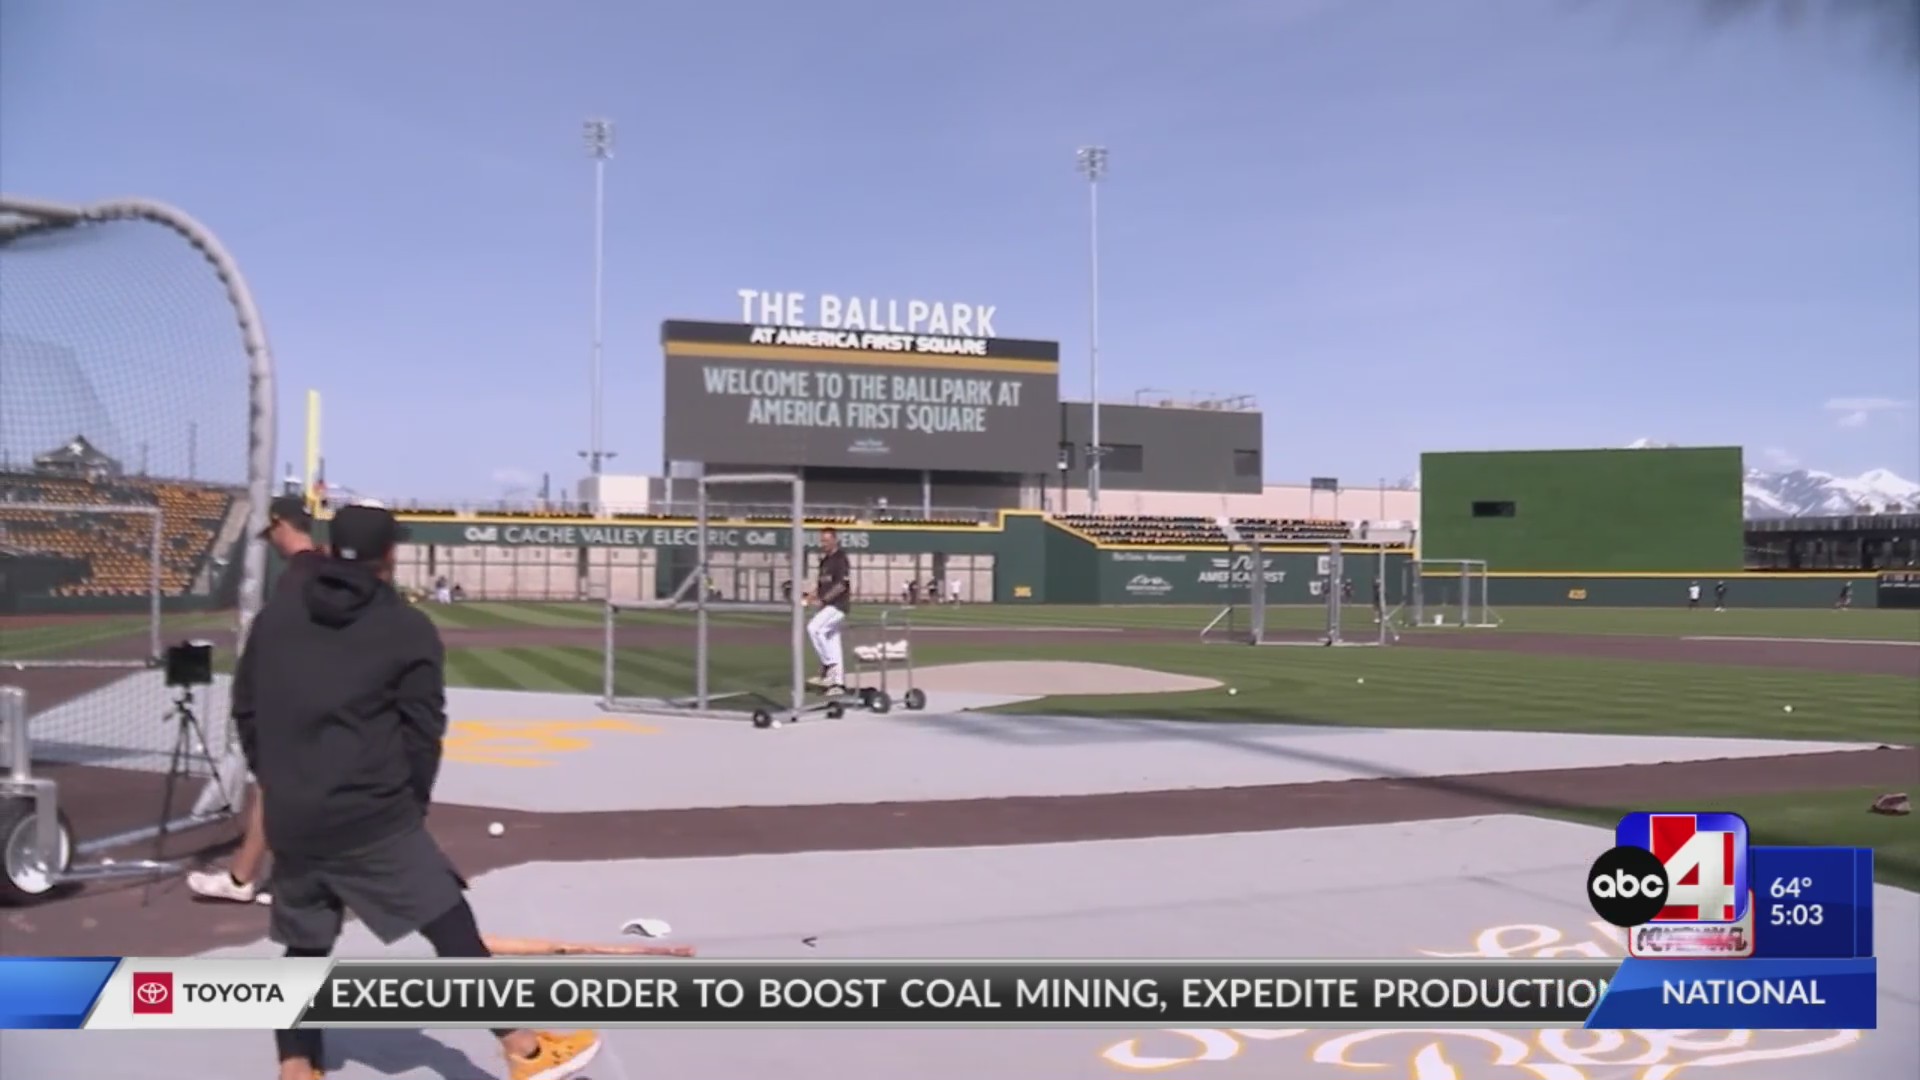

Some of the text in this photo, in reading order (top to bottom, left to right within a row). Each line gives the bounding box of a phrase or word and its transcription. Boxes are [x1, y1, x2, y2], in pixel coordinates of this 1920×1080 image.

[738, 288, 997, 338] THE BALLPARK
[750, 327, 987, 356] AT AMERICA FIRST SQUARE
[703, 366, 1022, 407] WELCOME TO THE BALLPARK AT
[747, 398, 986, 434] AMERICA FIRST SQUARE
[503, 526, 576, 544] CACHE
[578, 526, 648, 545] VALLEY
[652, 527, 740, 547] ELECRIC
